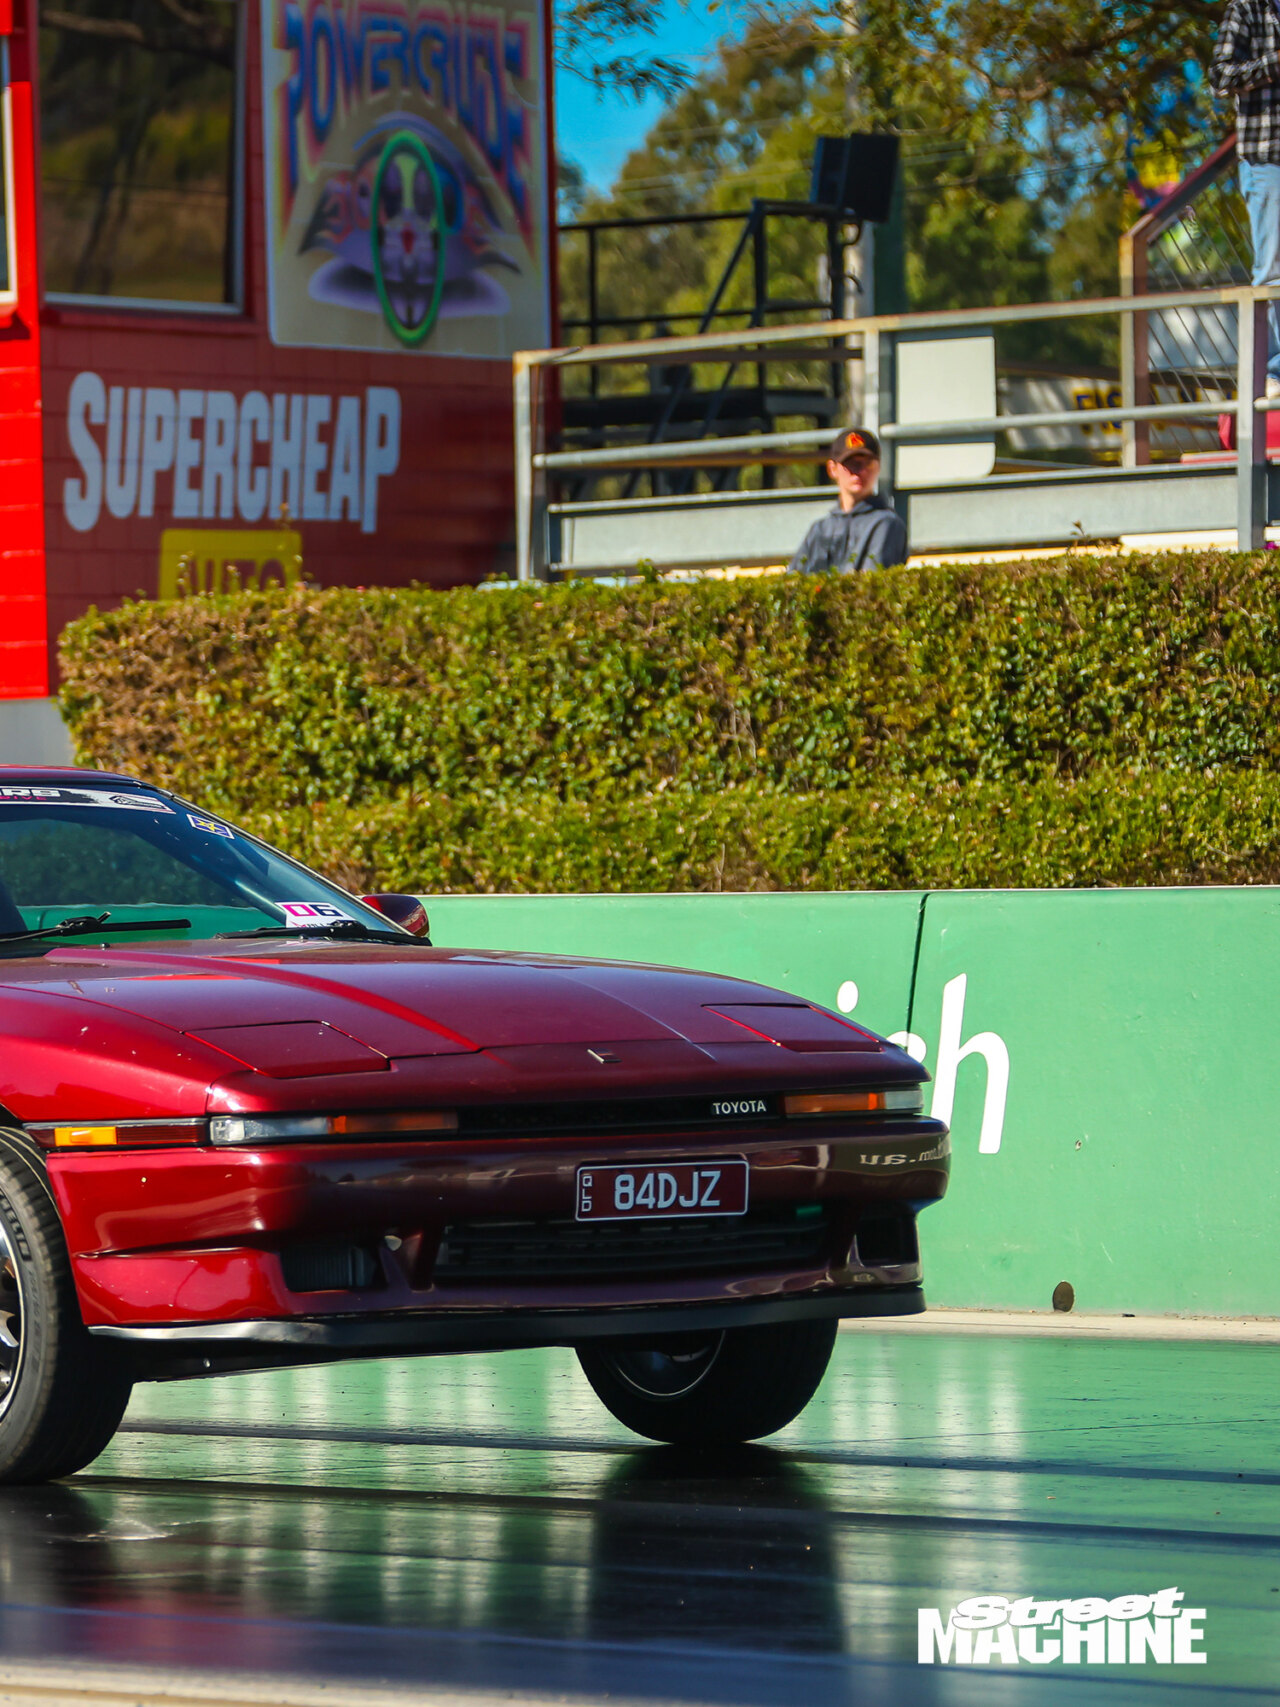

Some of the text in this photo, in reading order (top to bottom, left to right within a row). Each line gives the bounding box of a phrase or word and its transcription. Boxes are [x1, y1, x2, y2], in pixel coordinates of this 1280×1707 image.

[64, 371, 402, 533] SUPERCHEAP
[281, 904, 344, 917] 06
[713, 1100, 767, 1116] TOYOTA
[581, 1174, 593, 1212] QLD
[614, 1170, 722, 1211] 84DJZ
